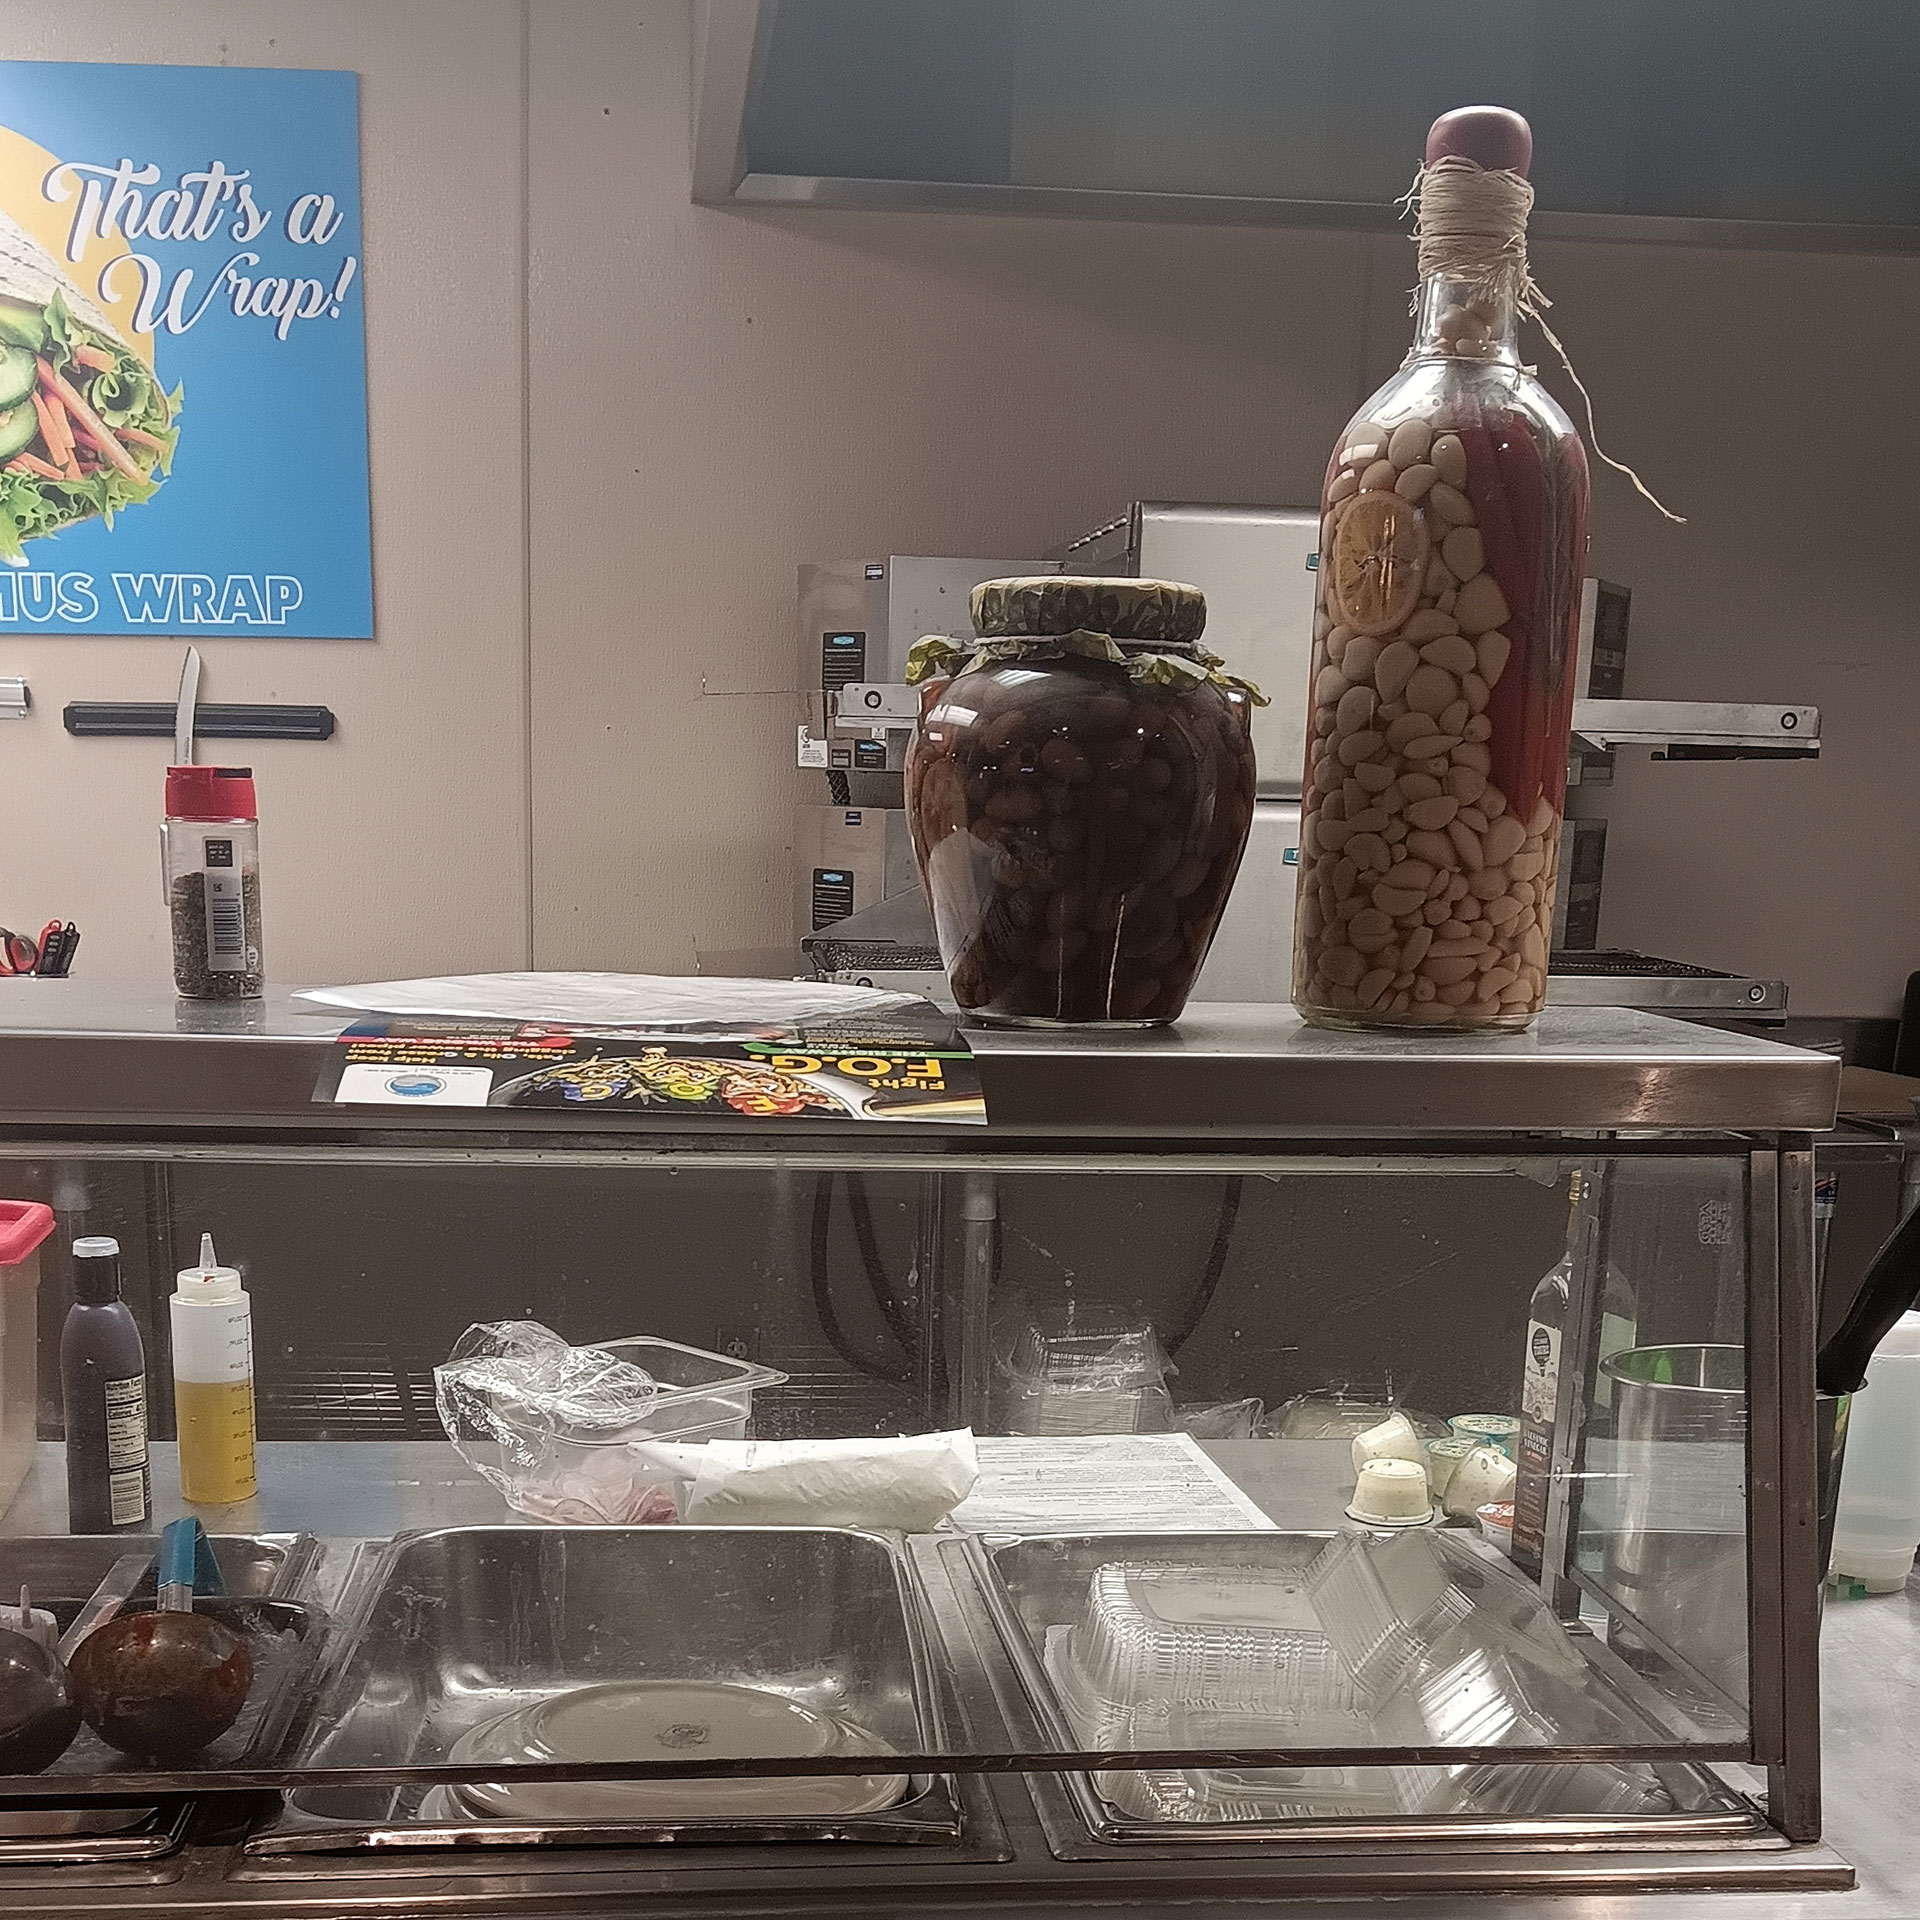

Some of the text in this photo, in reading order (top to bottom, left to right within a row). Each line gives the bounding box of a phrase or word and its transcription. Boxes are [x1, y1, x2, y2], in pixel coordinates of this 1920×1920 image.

[42, 158, 344, 263] That's a
[97, 252, 357, 341] Wrap!
[111, 573, 303, 625] WRAP
[749, 1054, 942, 1077] F.O.G.
[867, 1078, 945, 1090] Fight
